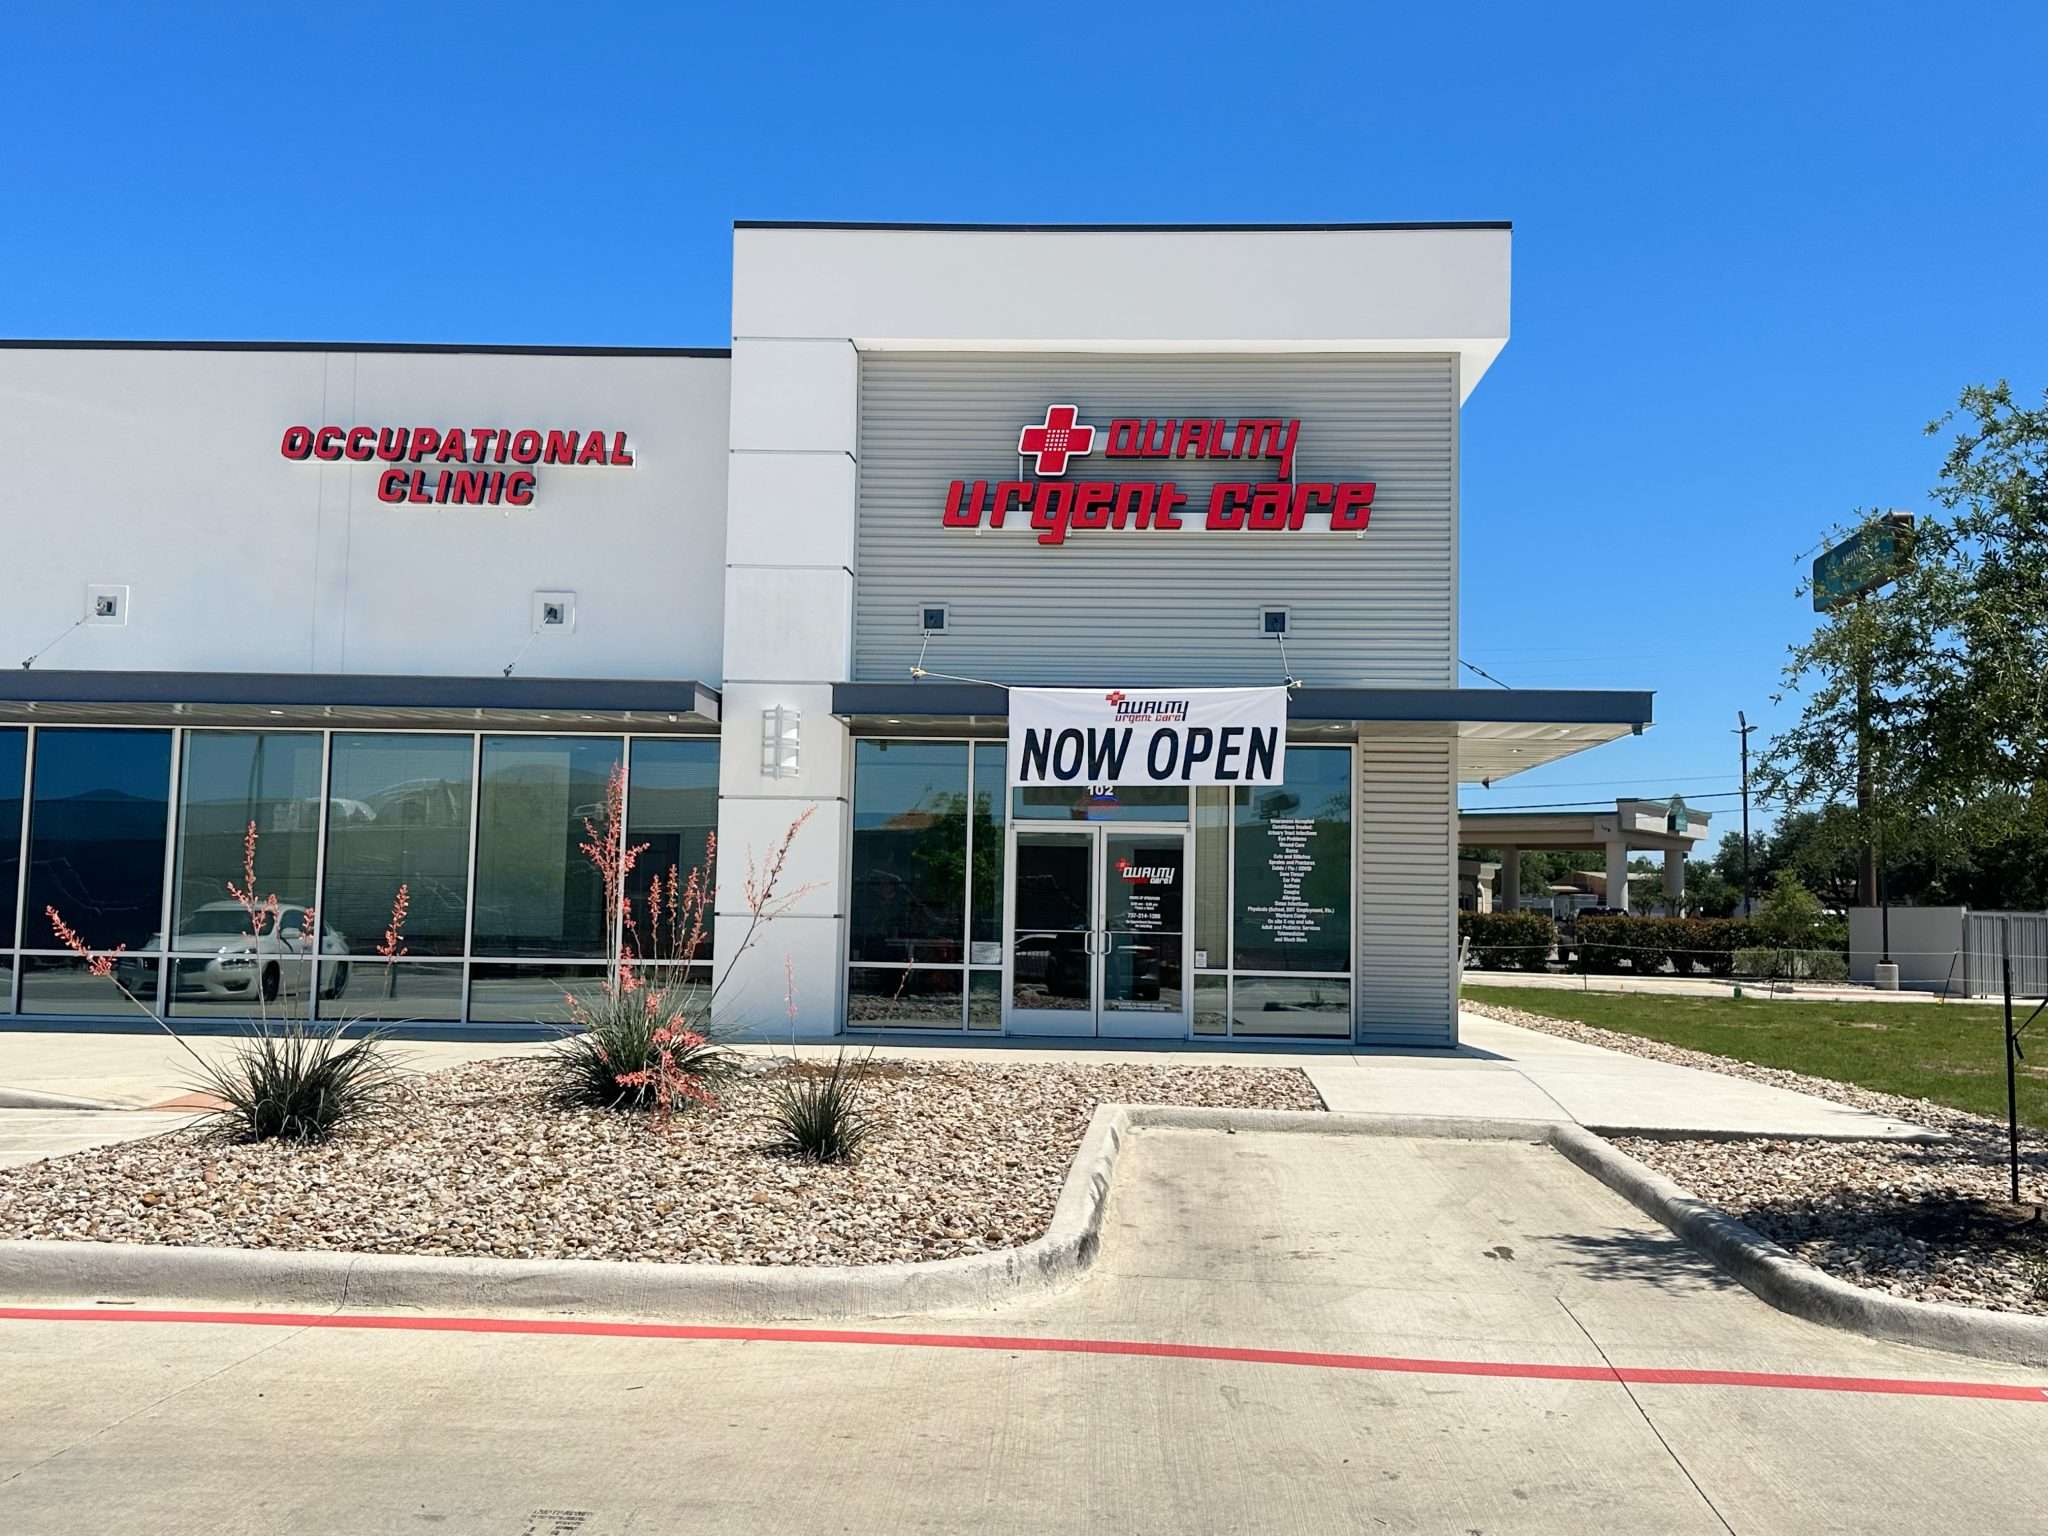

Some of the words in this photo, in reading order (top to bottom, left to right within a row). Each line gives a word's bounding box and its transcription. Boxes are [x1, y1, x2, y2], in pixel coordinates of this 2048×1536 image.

[281, 425, 635, 465] OCCUPATIONAL
[1105, 418, 1301, 480] QUALITY
[377, 469, 536, 505] CLINIC
[943, 480, 1188, 544] urgent
[1206, 482, 1377, 531] care
[1117, 701, 1189, 721] QUALITY
[1019, 727, 1133, 781] NOW
[1147, 726, 1278, 780] OPEN
[1087, 784, 1114, 796] 102
[1123, 867, 1175, 884] QUALITY
